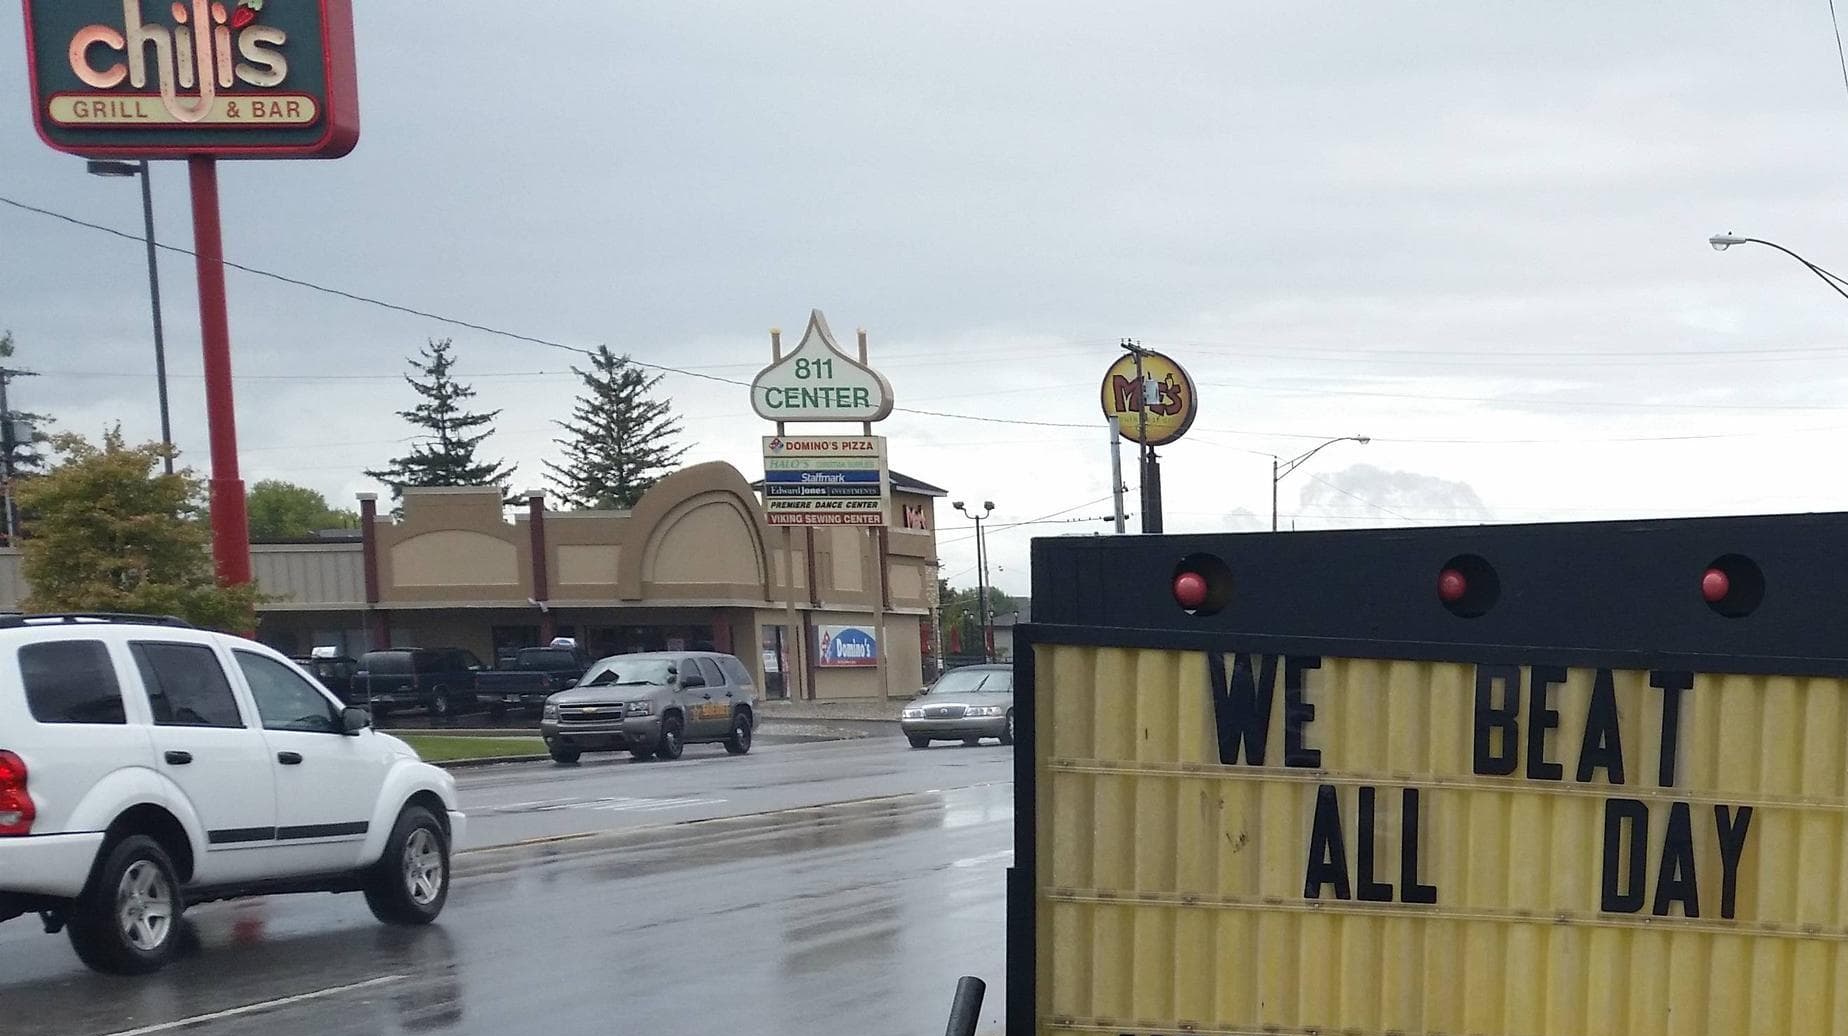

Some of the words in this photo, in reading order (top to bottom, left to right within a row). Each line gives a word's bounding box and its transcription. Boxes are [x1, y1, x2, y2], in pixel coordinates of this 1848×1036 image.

[68, 0, 288, 122] chili's
[73, 101, 148, 118] GRILL
[227, 101, 240, 118] &
[252, 101, 301, 117] BAR
[795, 358, 833, 379] 811
[765, 387, 870, 409] CENTER
[786, 442, 838, 450] DOMINO'S
[842, 442, 874, 450] PIZZA
[801, 473, 846, 483] Staffmark
[771, 486, 801, 495] Edward
[801, 487, 826, 495] Jones
[771, 515, 802, 523] VIKING
[805, 515, 841, 523] SEWING
[844, 515, 880, 523] CENTER
[836, 638, 871, 658] Domino's
[1207, 652, 1322, 768] WE
[1473, 664, 1694, 787] BEAT
[1304, 784, 1437, 904] ALL
[1601, 798, 1753, 919] DAY
